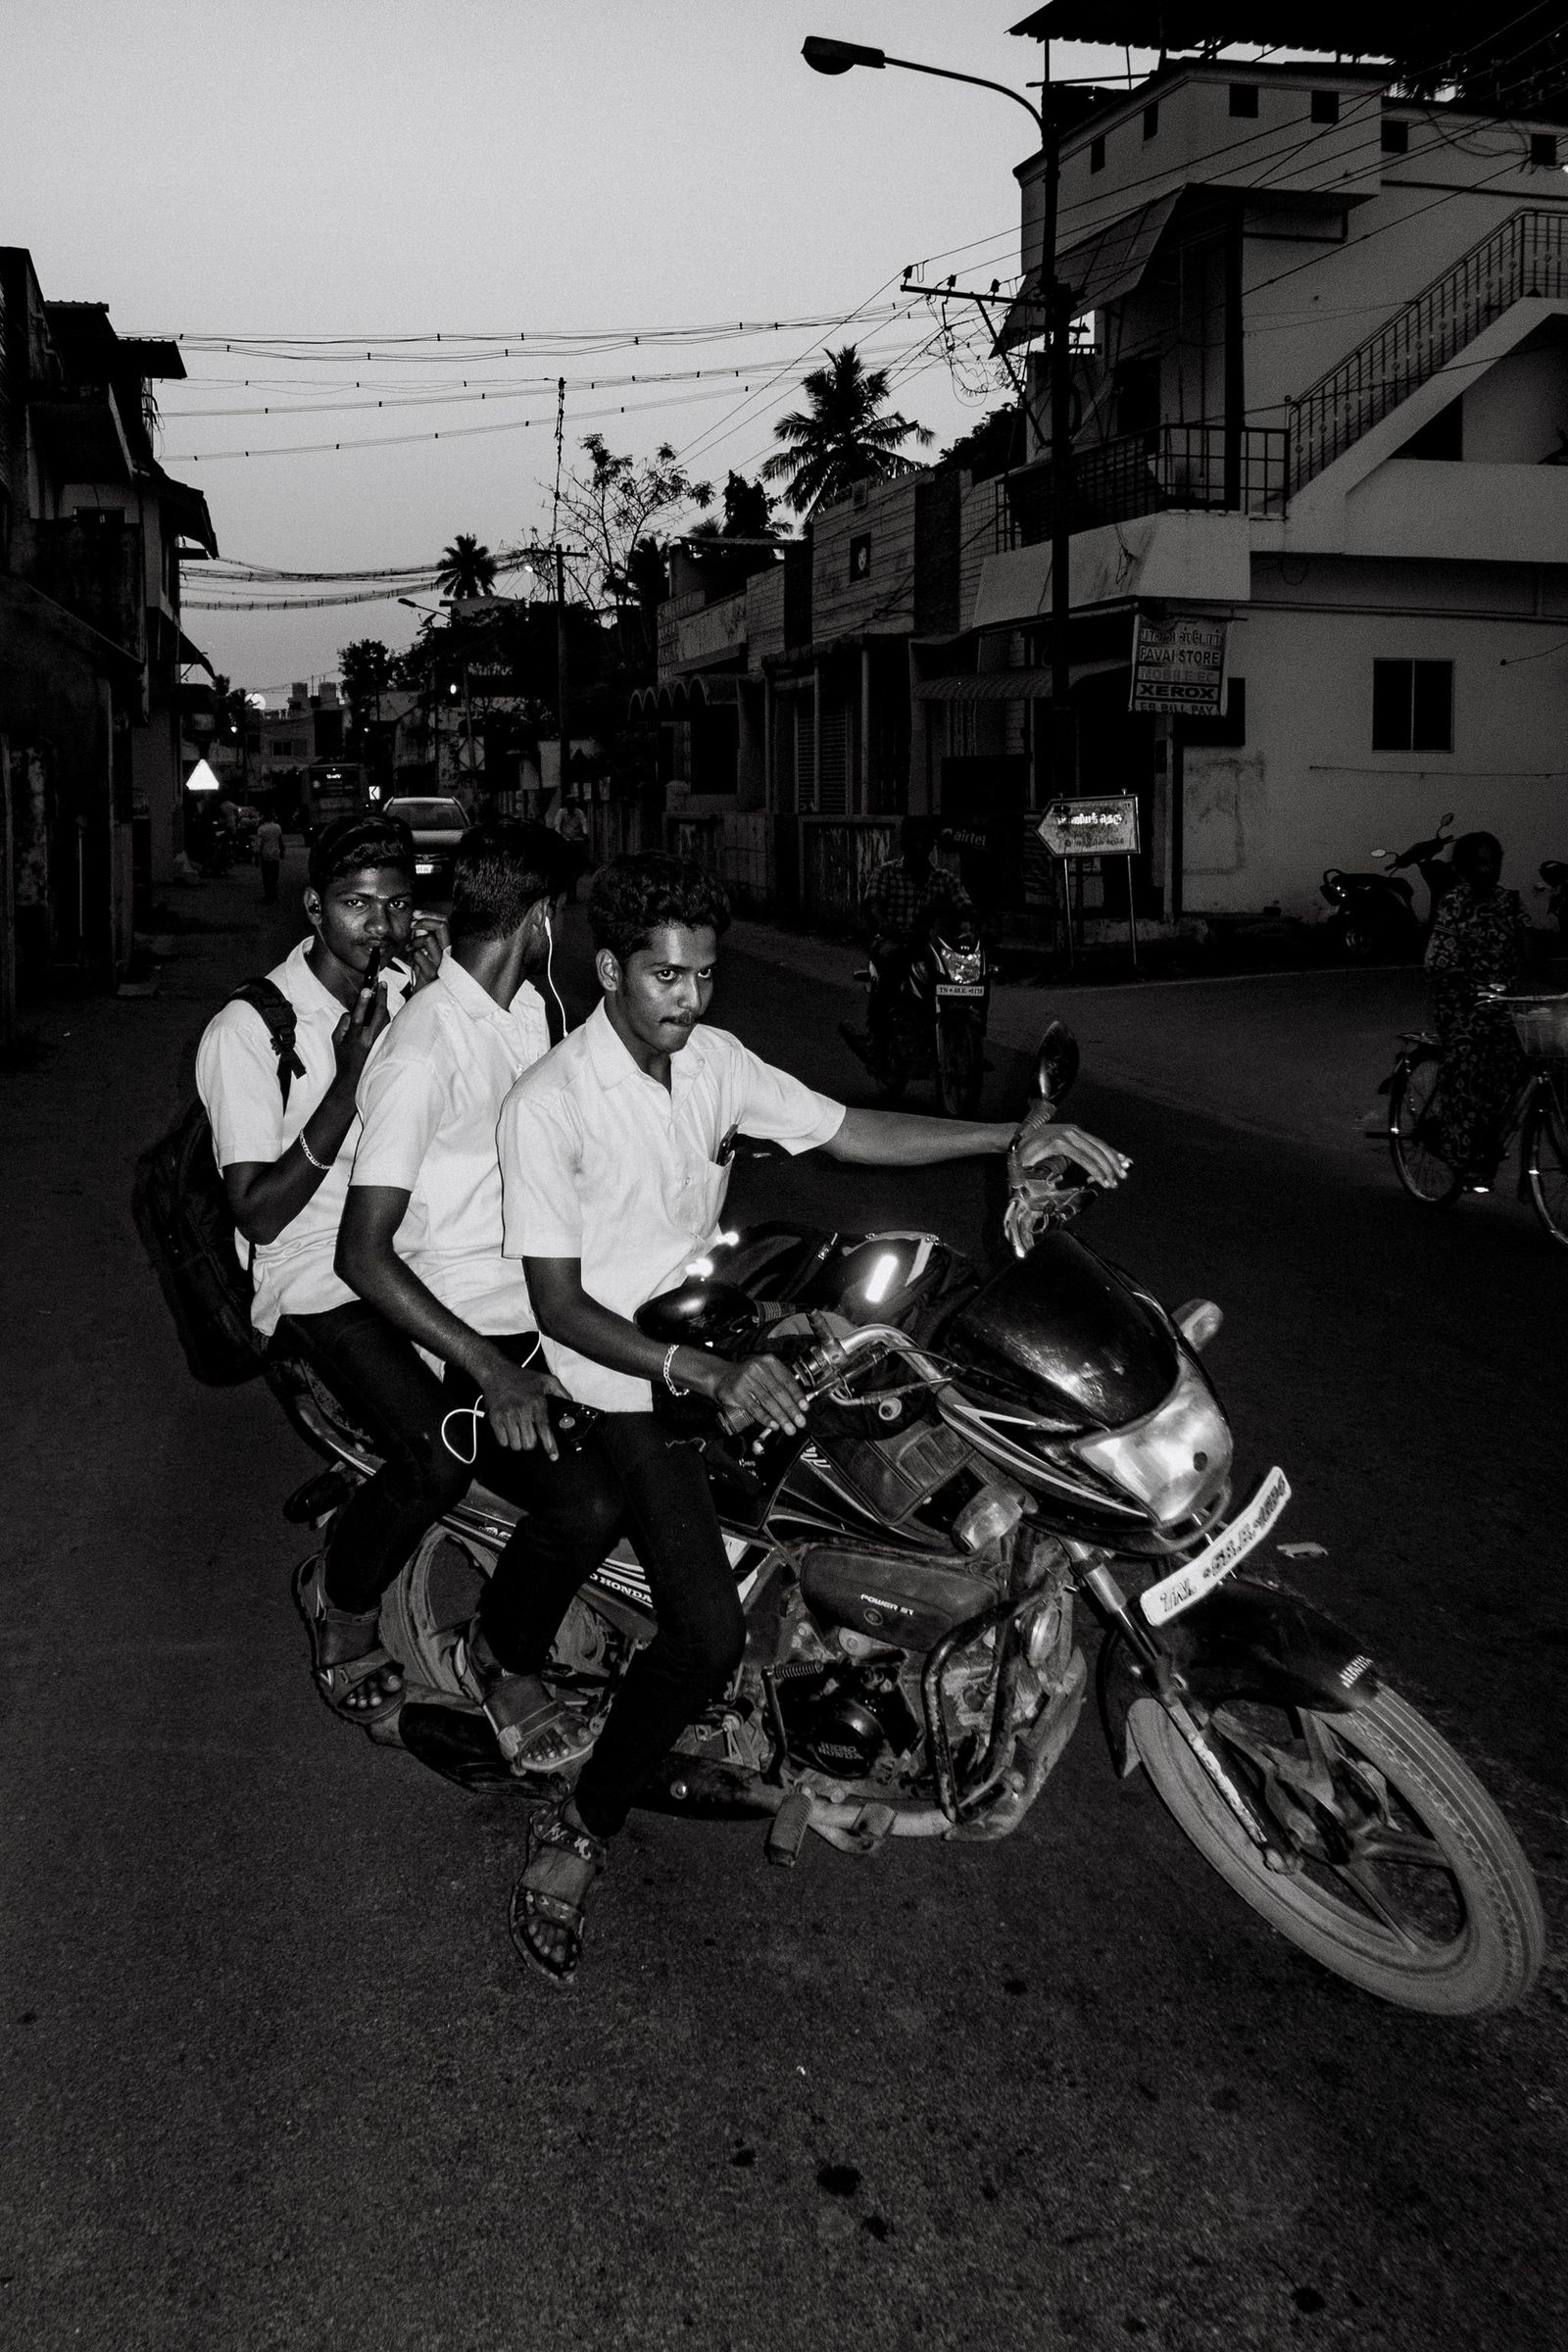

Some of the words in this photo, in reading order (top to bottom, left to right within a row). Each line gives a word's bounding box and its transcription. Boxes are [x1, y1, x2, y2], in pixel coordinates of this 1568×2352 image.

[1140, 647, 1175, 662] PAVAI
[1178, 650, 1219, 664] STORE
[1141, 666, 1194, 681] MOBILE
[1140, 684, 1214, 699] XEROX
[1192, 705, 1214, 714] PAY
[954, 829, 986, 847] airtel
[600, 1576, 653, 1603] HONDA
[860, 1593, 899, 1611] POWER
[817, 1745, 863, 1760] HONDA
[819, 1740, 857, 1752] HERO
